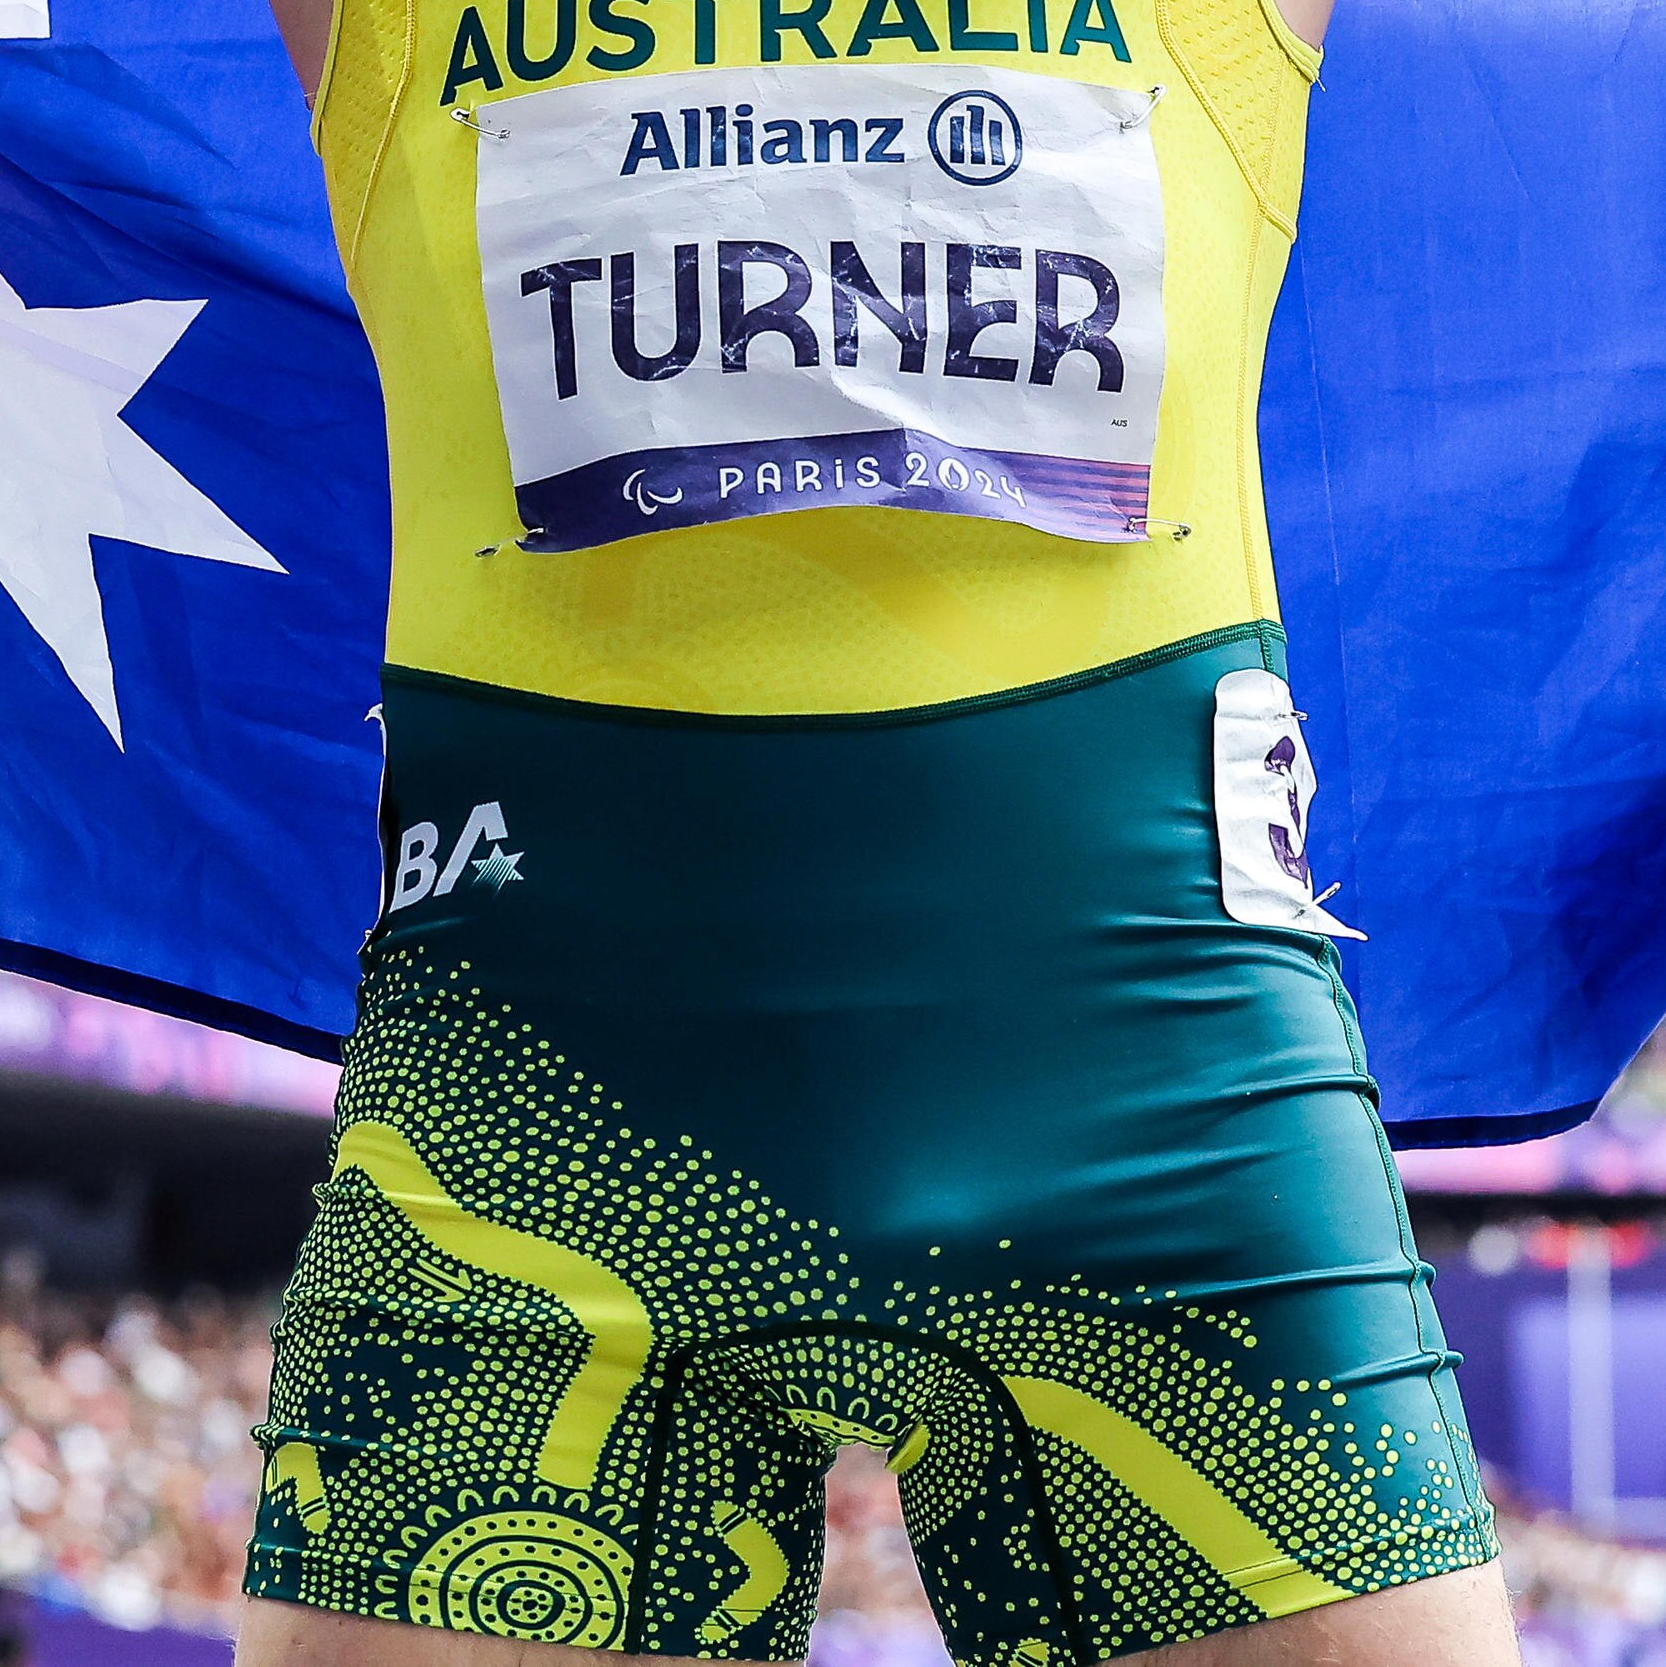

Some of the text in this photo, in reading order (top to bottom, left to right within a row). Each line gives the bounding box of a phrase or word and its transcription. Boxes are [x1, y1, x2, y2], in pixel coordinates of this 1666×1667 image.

[620, 104, 905, 176] Allianz
[521, 240, 1126, 401] TURNER
[1111, 419, 1128, 427] AUS
[904, 453, 1027, 508] 2024
